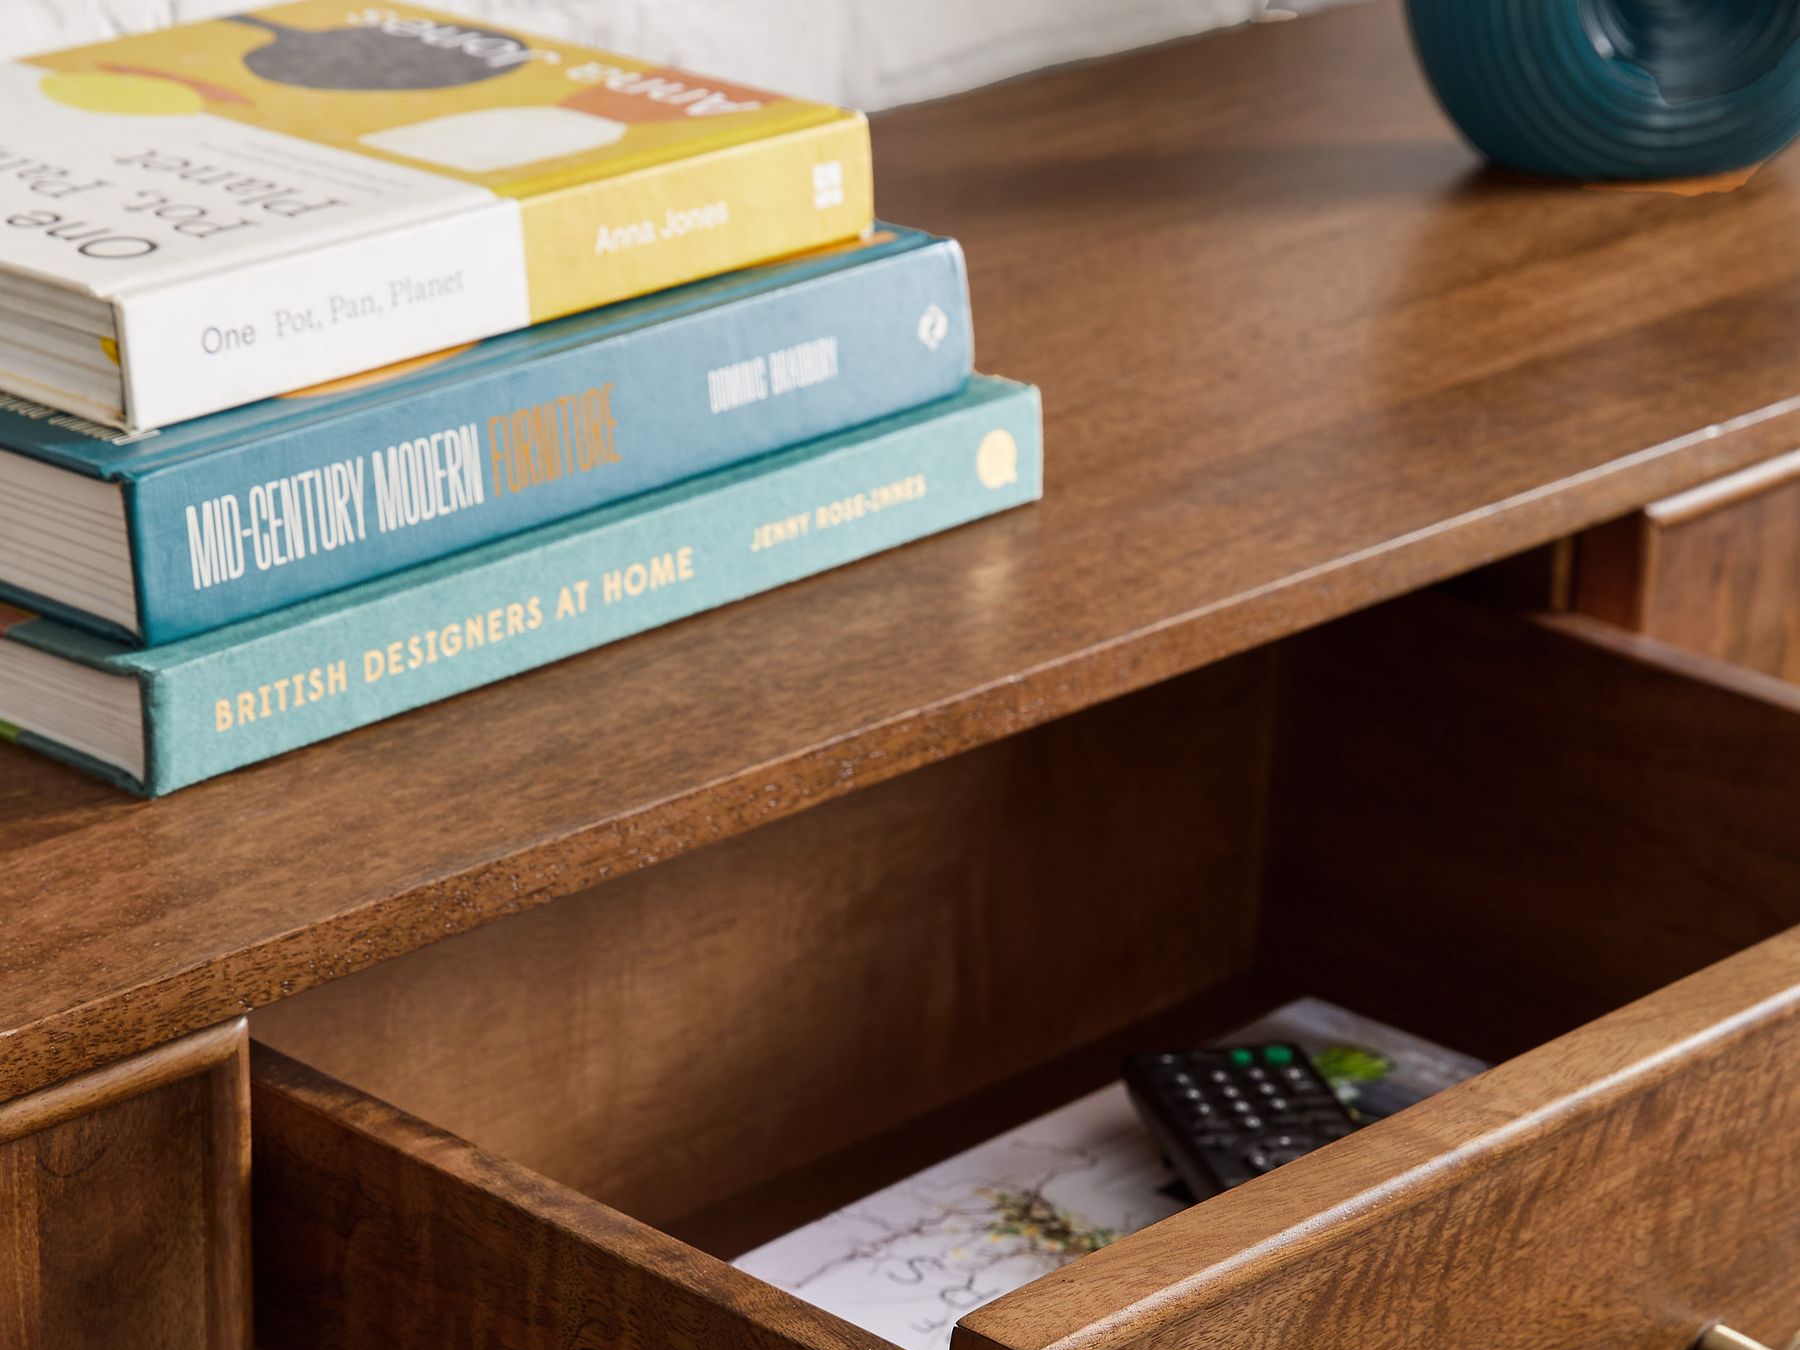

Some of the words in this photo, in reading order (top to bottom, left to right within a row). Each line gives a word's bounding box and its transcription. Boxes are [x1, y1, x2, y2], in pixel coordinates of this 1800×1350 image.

[565, 62, 761, 117] Anna
[112, 149, 349, 218] Planet
[5, 212, 160, 260] One
[595, 224, 656, 254] Anna
[660, 201, 729, 239] Jones
[201, 326, 256, 354] One
[274, 308, 323, 337] Pot,
[329, 294, 383, 324] Pan,
[388, 269, 465, 308] Planet
[185, 455, 366, 591] MID-CENTURY
[371, 422, 485, 534] MODERN
[487, 383, 623, 498] FURNITURE
[750, 511, 810, 552] JENNY
[815, 473, 926, 529] ROSE-INNES
[214, 659, 347, 733] BRITISH
[363, 597, 543, 684] DESIGNERS
[556, 580, 590, 620] AT
[603, 545, 694, 604] HOME
